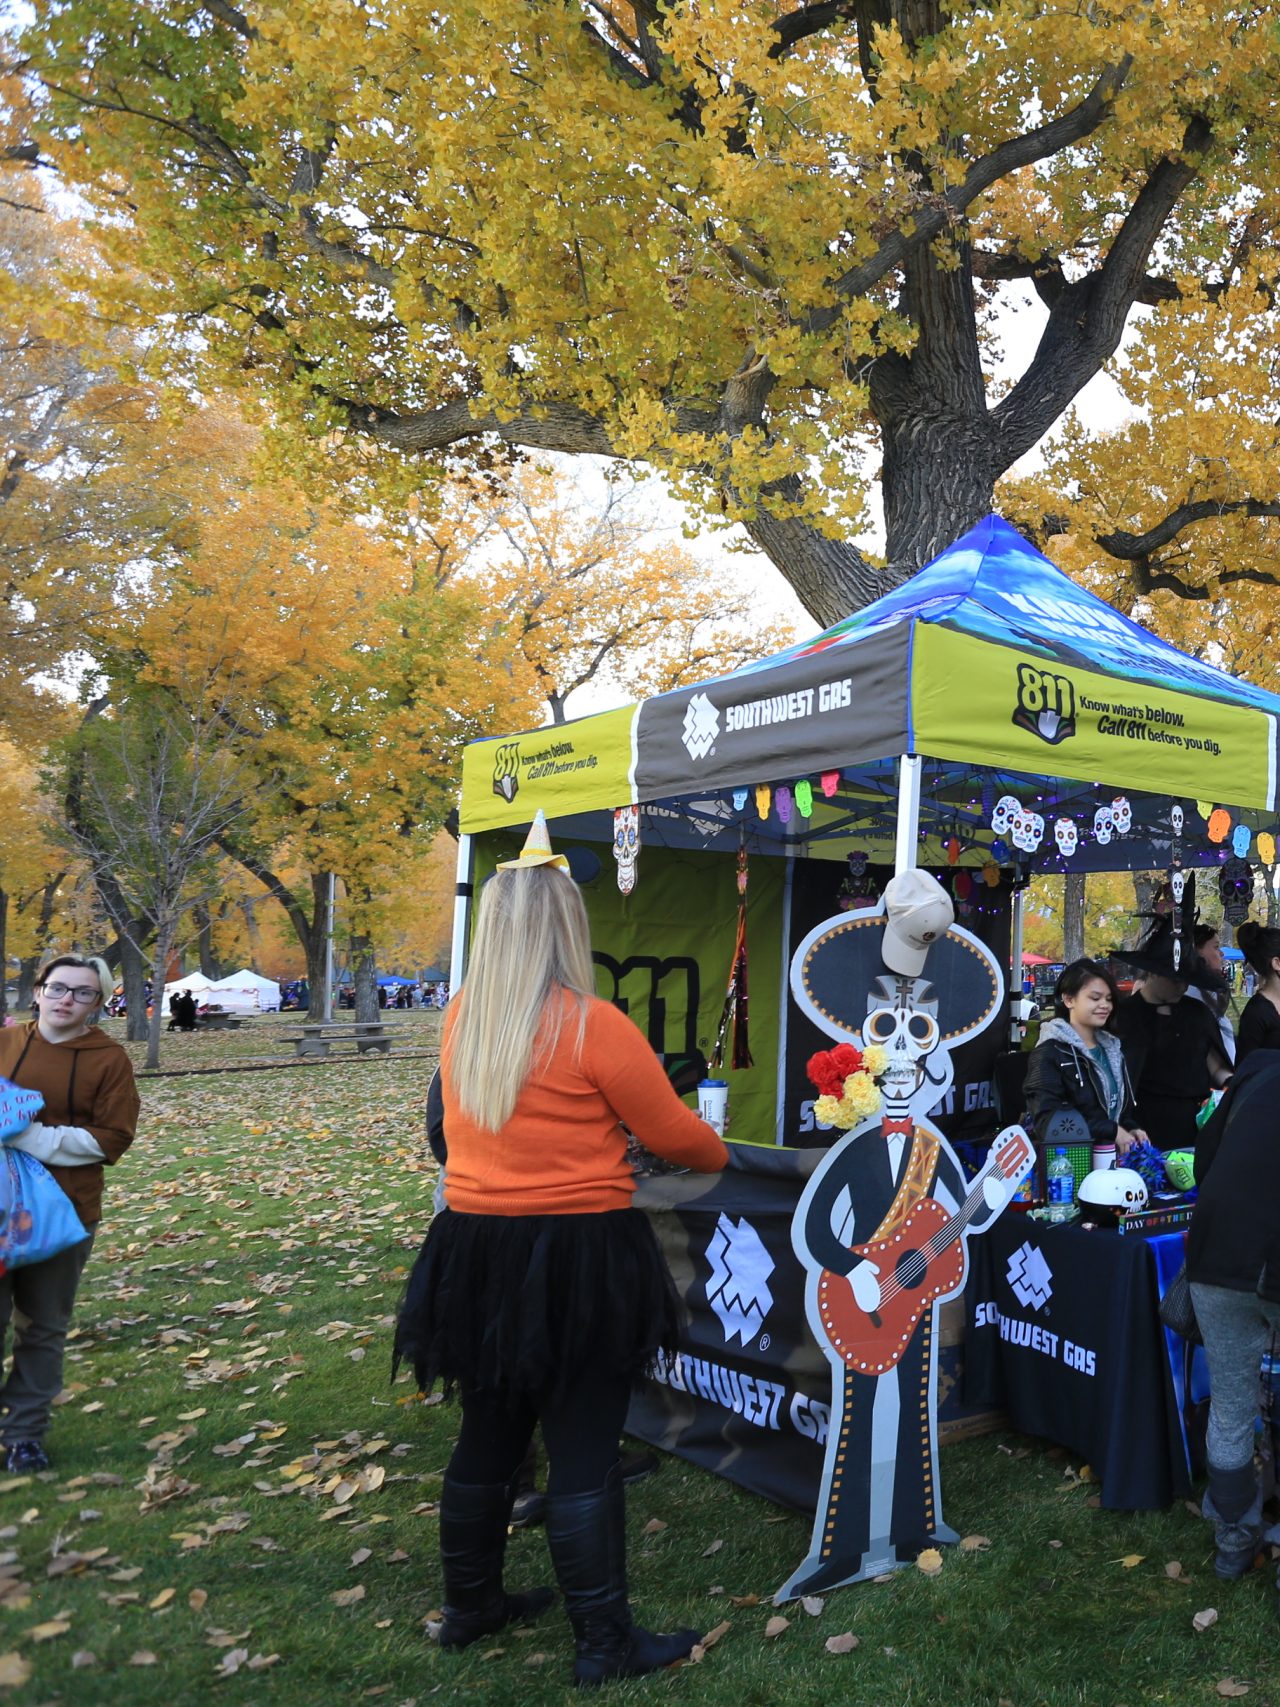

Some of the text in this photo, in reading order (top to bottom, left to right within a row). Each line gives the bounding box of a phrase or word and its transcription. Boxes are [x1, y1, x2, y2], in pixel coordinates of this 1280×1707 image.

[726, 678, 852, 732] SOUTHWEST GAS
[1018, 665, 1074, 718] 811
[1079, 696, 1185, 727] Know what's below.
[521, 755, 536, 765] Know
[551, 741, 574, 757] below.
[1097, 715, 1221, 756] Call 811 before you dig.
[494, 742, 520, 781] 811
[527, 763, 545, 780] Call
[553, 761, 574, 774] before
[964, 1081, 995, 1112] GA
[1126, 1219, 1144, 1230] DAY
[1146, 1217, 1160, 1227] OF
[1167, 1213, 1185, 1223] THE
[975, 1301, 1096, 1376] SOHWEST GAS
[790, 1391, 832, 1445] GA
